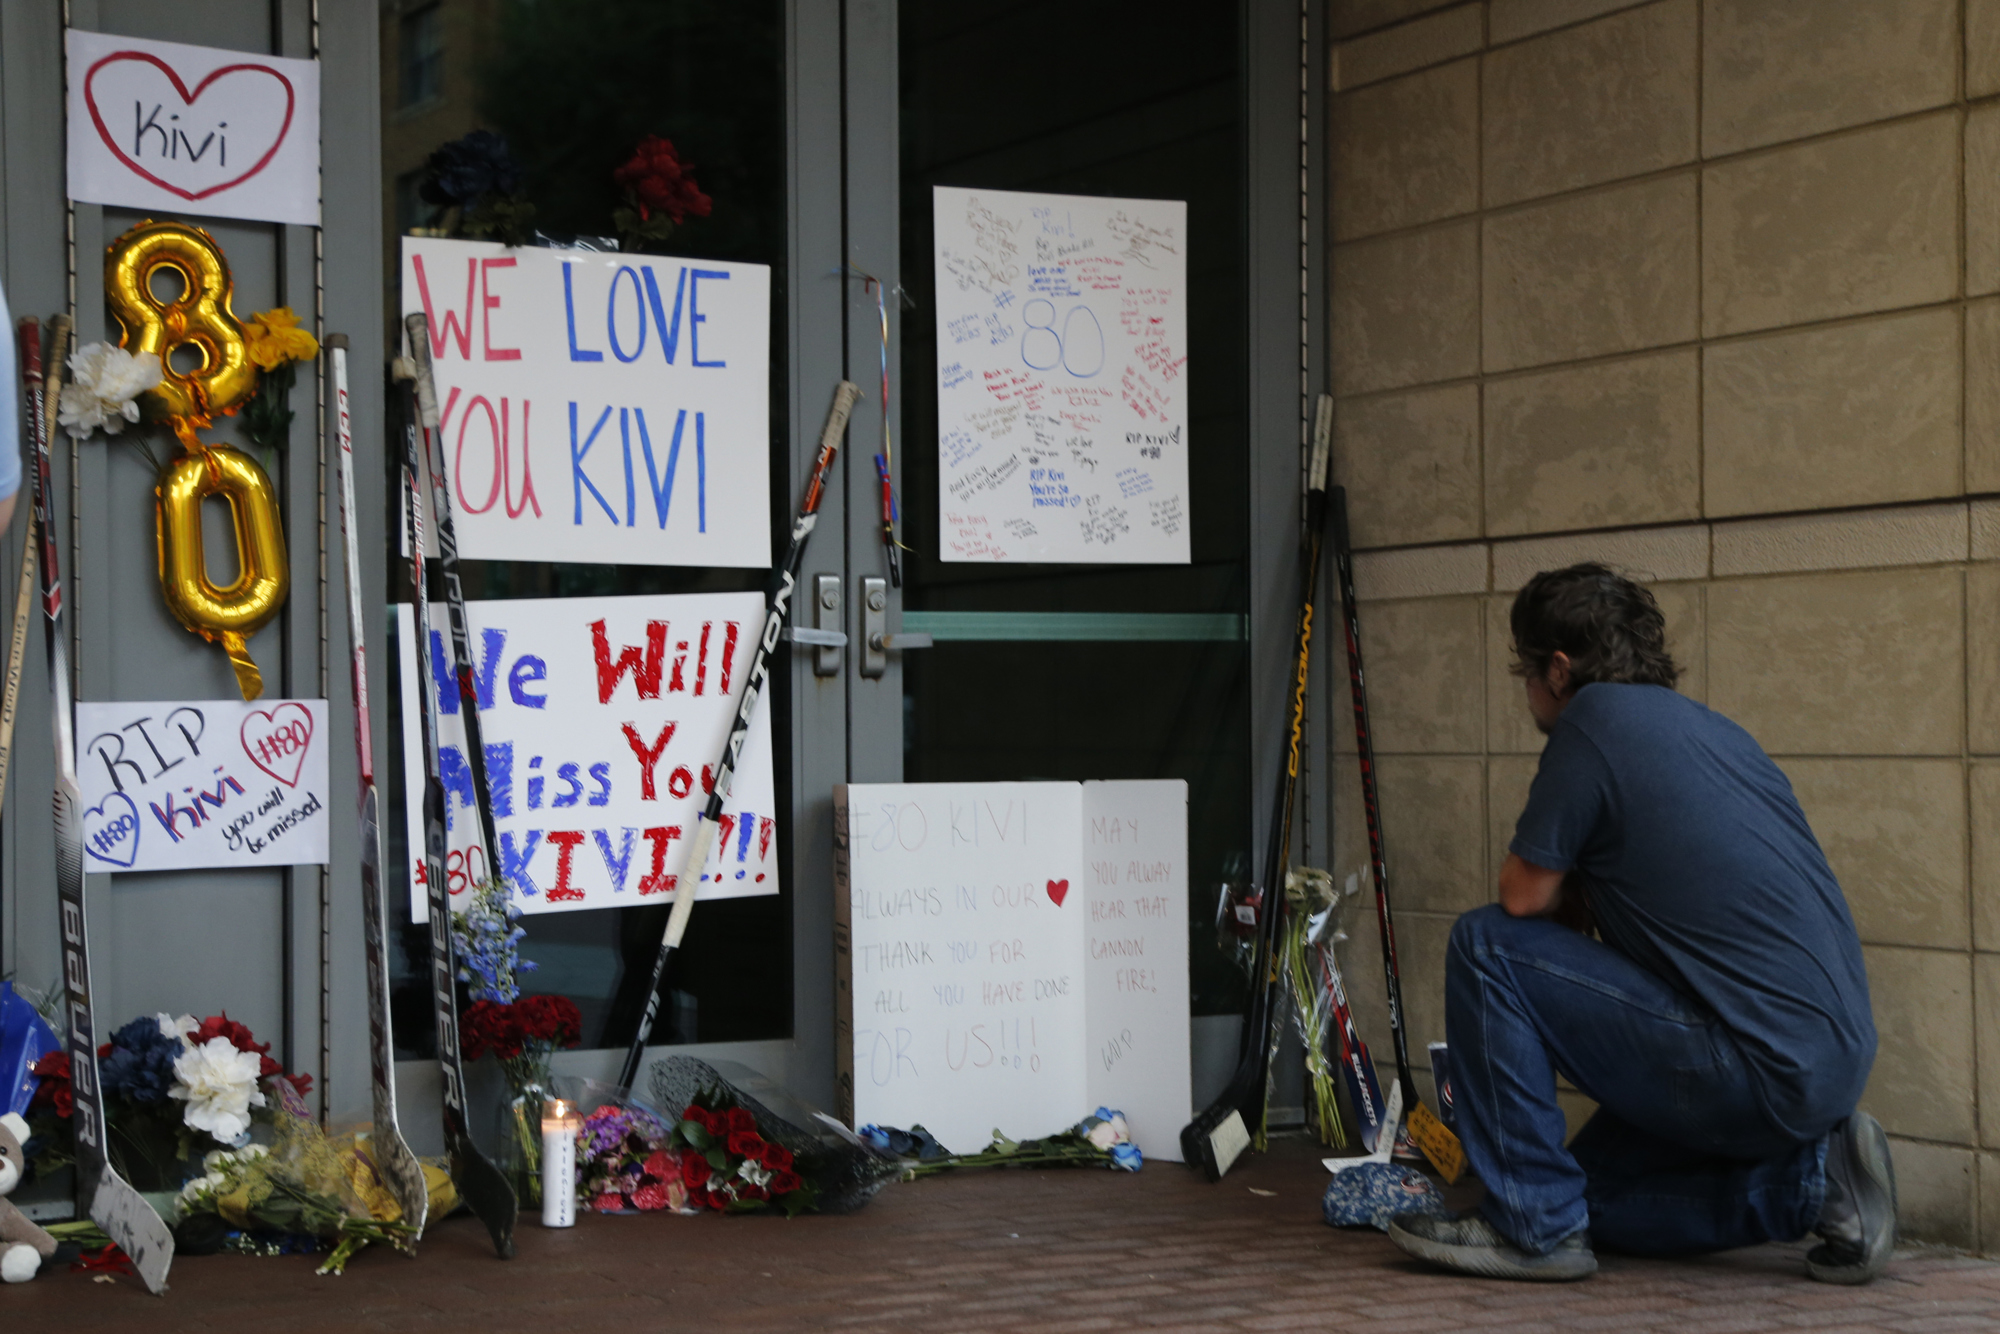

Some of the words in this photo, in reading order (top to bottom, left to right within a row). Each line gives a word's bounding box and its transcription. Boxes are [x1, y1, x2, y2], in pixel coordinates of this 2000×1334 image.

[134, 99, 228, 167] Kivi
[411, 253, 523, 362] WE
[561, 260, 731, 369] LOVE
[1022, 298, 1105, 379] 80
[338, 387, 353, 455] CCM
[1125, 432, 1143, 444] RIP
[567, 400, 707, 534] KIVI
[1030, 468, 1046, 482] RIP
[429, 627, 548, 715] We
[586, 617, 741, 705] Will
[714, 569, 796, 802] EASTON
[86, 706, 206, 793] RIP
[253, 719, 311, 766] #80
[148, 765, 247, 844] Kivi
[438, 739, 613, 832] Miss
[91, 812, 136, 854] #80
[221, 810, 256, 852] you
[257, 785, 286, 816] will
[243, 834, 268, 855] be
[266, 790, 323, 843] missed
[949, 798, 1028, 848] KIVI
[1090, 816, 1139, 845] MAY
[849, 886, 943, 921] ALWAYS
[955, 885, 978, 912] IN
[991, 882, 1040, 910] OUR
[1090, 860, 1119, 887] YOU
[1090, 899, 1127, 924] HEAR
[1134, 895, 1171, 920] THAT
[857, 940, 935, 975] THANK
[946, 939, 978, 967] YOU
[988, 937, 1026, 965] FOR
[1090, 936, 1146, 962] CANNON
[426, 851, 462, 1112] BAUER
[874, 988, 911, 1015] ALL
[932, 984, 965, 1007] YOU
[981, 979, 1026, 1008] HAVE
[1033, 975, 1072, 1002] DONE
[1115, 968, 1158, 995] FIRE!
[61, 897, 98, 1149] BAUER
[852, 1027, 919, 1088] FOR
